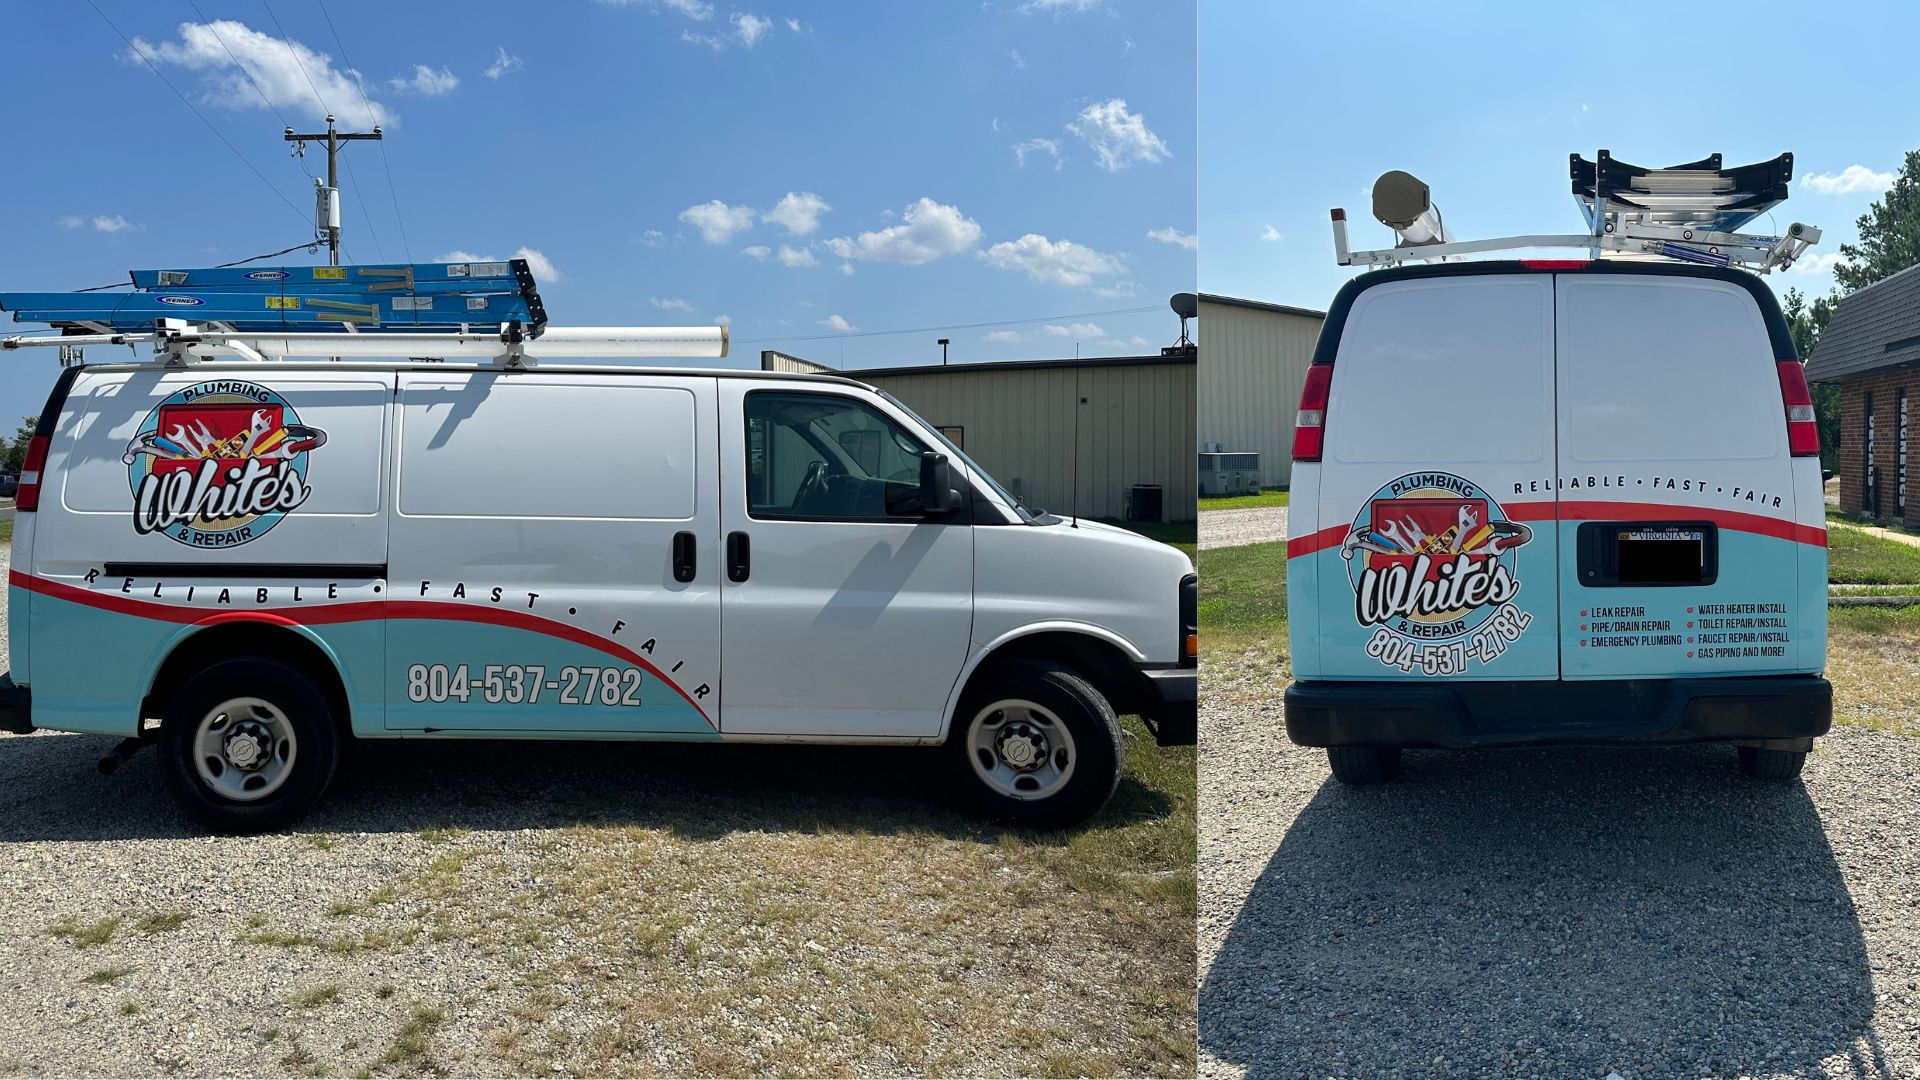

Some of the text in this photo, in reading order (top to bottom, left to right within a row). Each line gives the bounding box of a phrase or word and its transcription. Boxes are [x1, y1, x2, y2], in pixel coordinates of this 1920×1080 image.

[165, 296, 197, 304] WERNER
[183, 382, 270, 402] PLUMBING
[1899, 398, 1907, 507] MAGNETICS
[1391, 474, 1474, 498] PLUMBING
[1514, 475, 1782, 508] RELIABLE FAST FAIR
[134, 456, 312, 535] White's
[178, 528, 253, 546] & REPAIR
[1639, 531, 1682, 540] VIRGINIA
[1357, 554, 1519, 627] White's
[1591, 606, 1645, 618] LEAK REPAIR
[1698, 603, 1788, 615] WATER HEATER INSTALL
[1397, 620, 1467, 638] & REPAIR
[1591, 620, 1671, 633] PIPE/DRAIN REPAIR
[1698, 617, 1788, 629] TOILET REPAIR/INSTALL
[84, 568, 711, 700] RELIABLE FAST FAIR
[1366, 603, 1532, 675] 804-537-2782
[1591, 634, 1682, 647] EMERGENCY PLUMBING
[1698, 632, 1790, 644] FAUCET REPAIR/INSTALL
[1698, 646, 1785, 659] GAS PIPING AND MORE!
[407, 663, 643, 707] 804-537-2782
